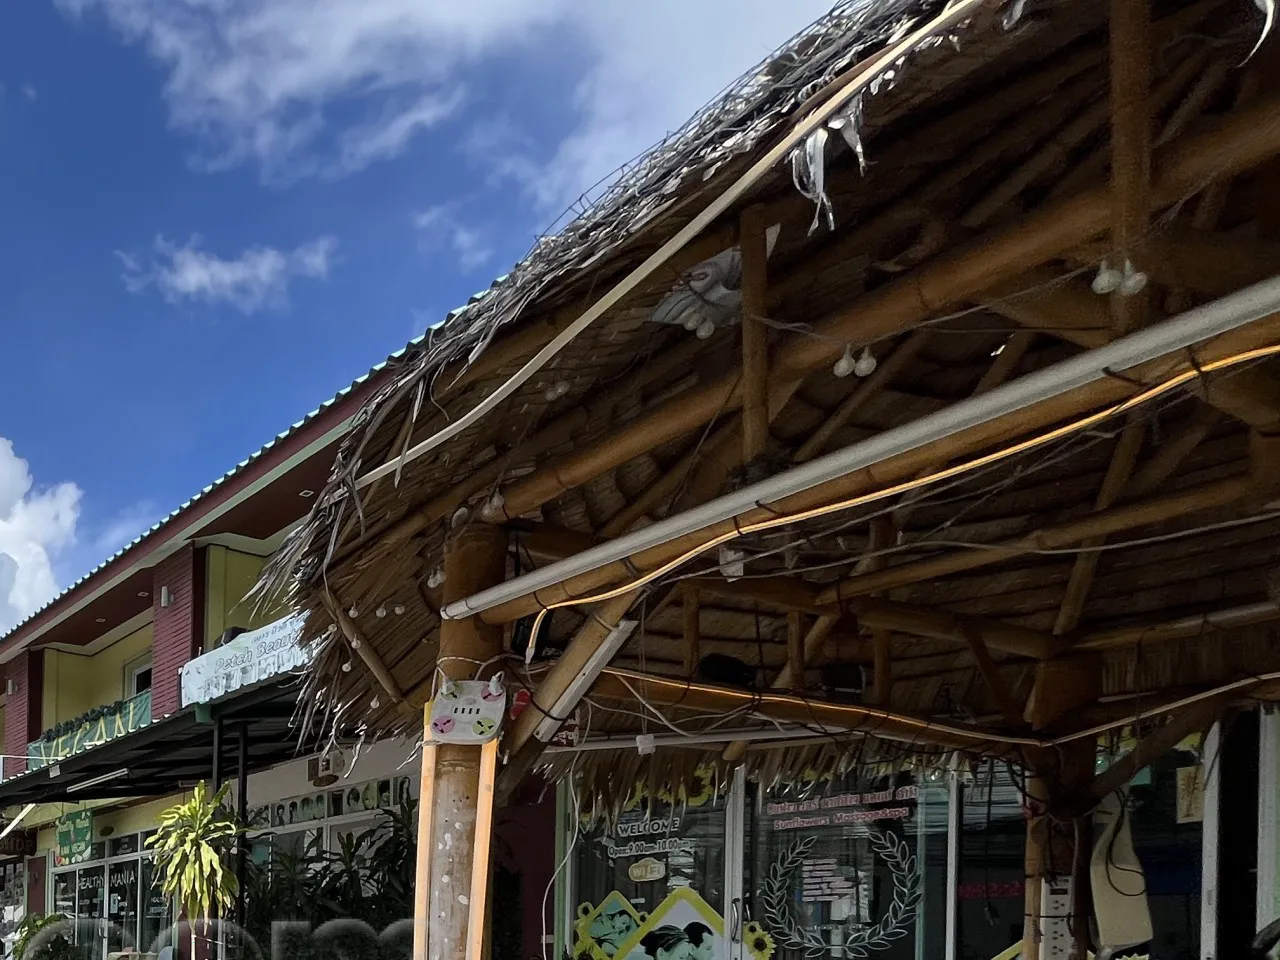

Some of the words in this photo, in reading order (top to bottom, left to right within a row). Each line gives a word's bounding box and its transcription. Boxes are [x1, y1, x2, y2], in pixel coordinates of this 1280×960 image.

[214, 646, 252, 673] Petch
[256, 630, 300, 658] Beaut
[618, 819, 680, 836] WELCOME
[111, 870, 136, 887] MANIA
